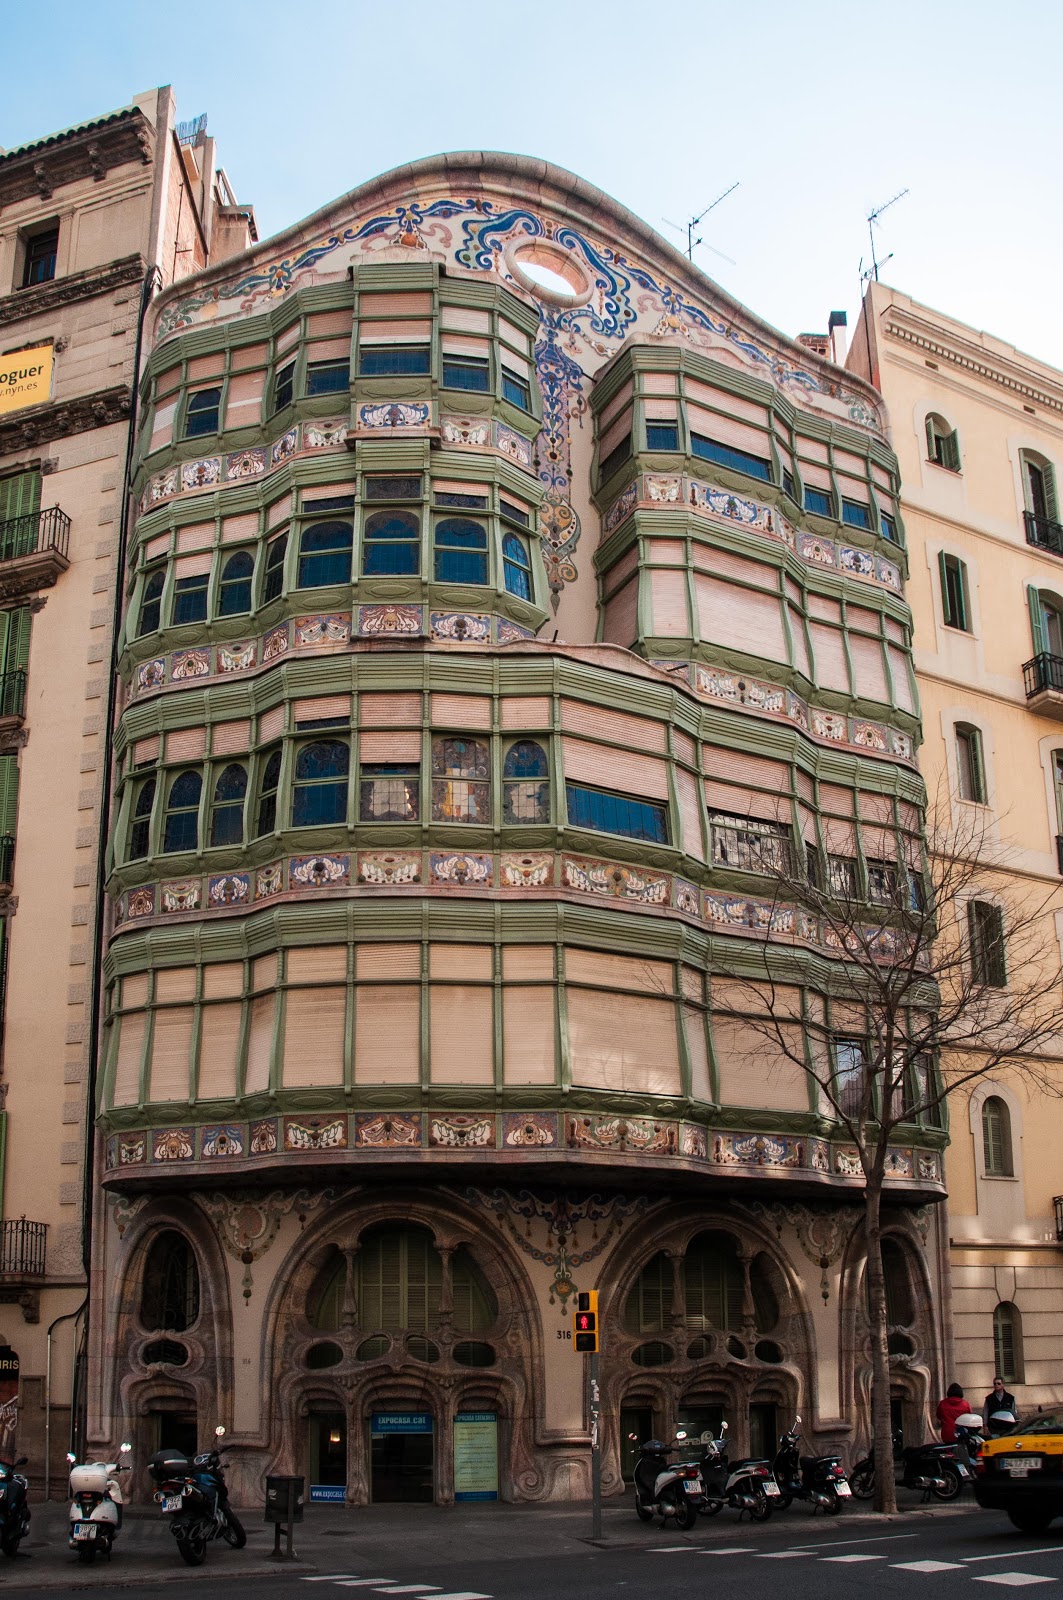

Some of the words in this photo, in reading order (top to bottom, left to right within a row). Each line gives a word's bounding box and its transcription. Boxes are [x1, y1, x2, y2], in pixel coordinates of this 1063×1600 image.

[0, 365, 44, 386] oguer
[556, 1330, 572, 1340] 316
[0, 1359, 19, 1370] RIS
[378, 1416, 426, 1424] EXPOCASA.cat
